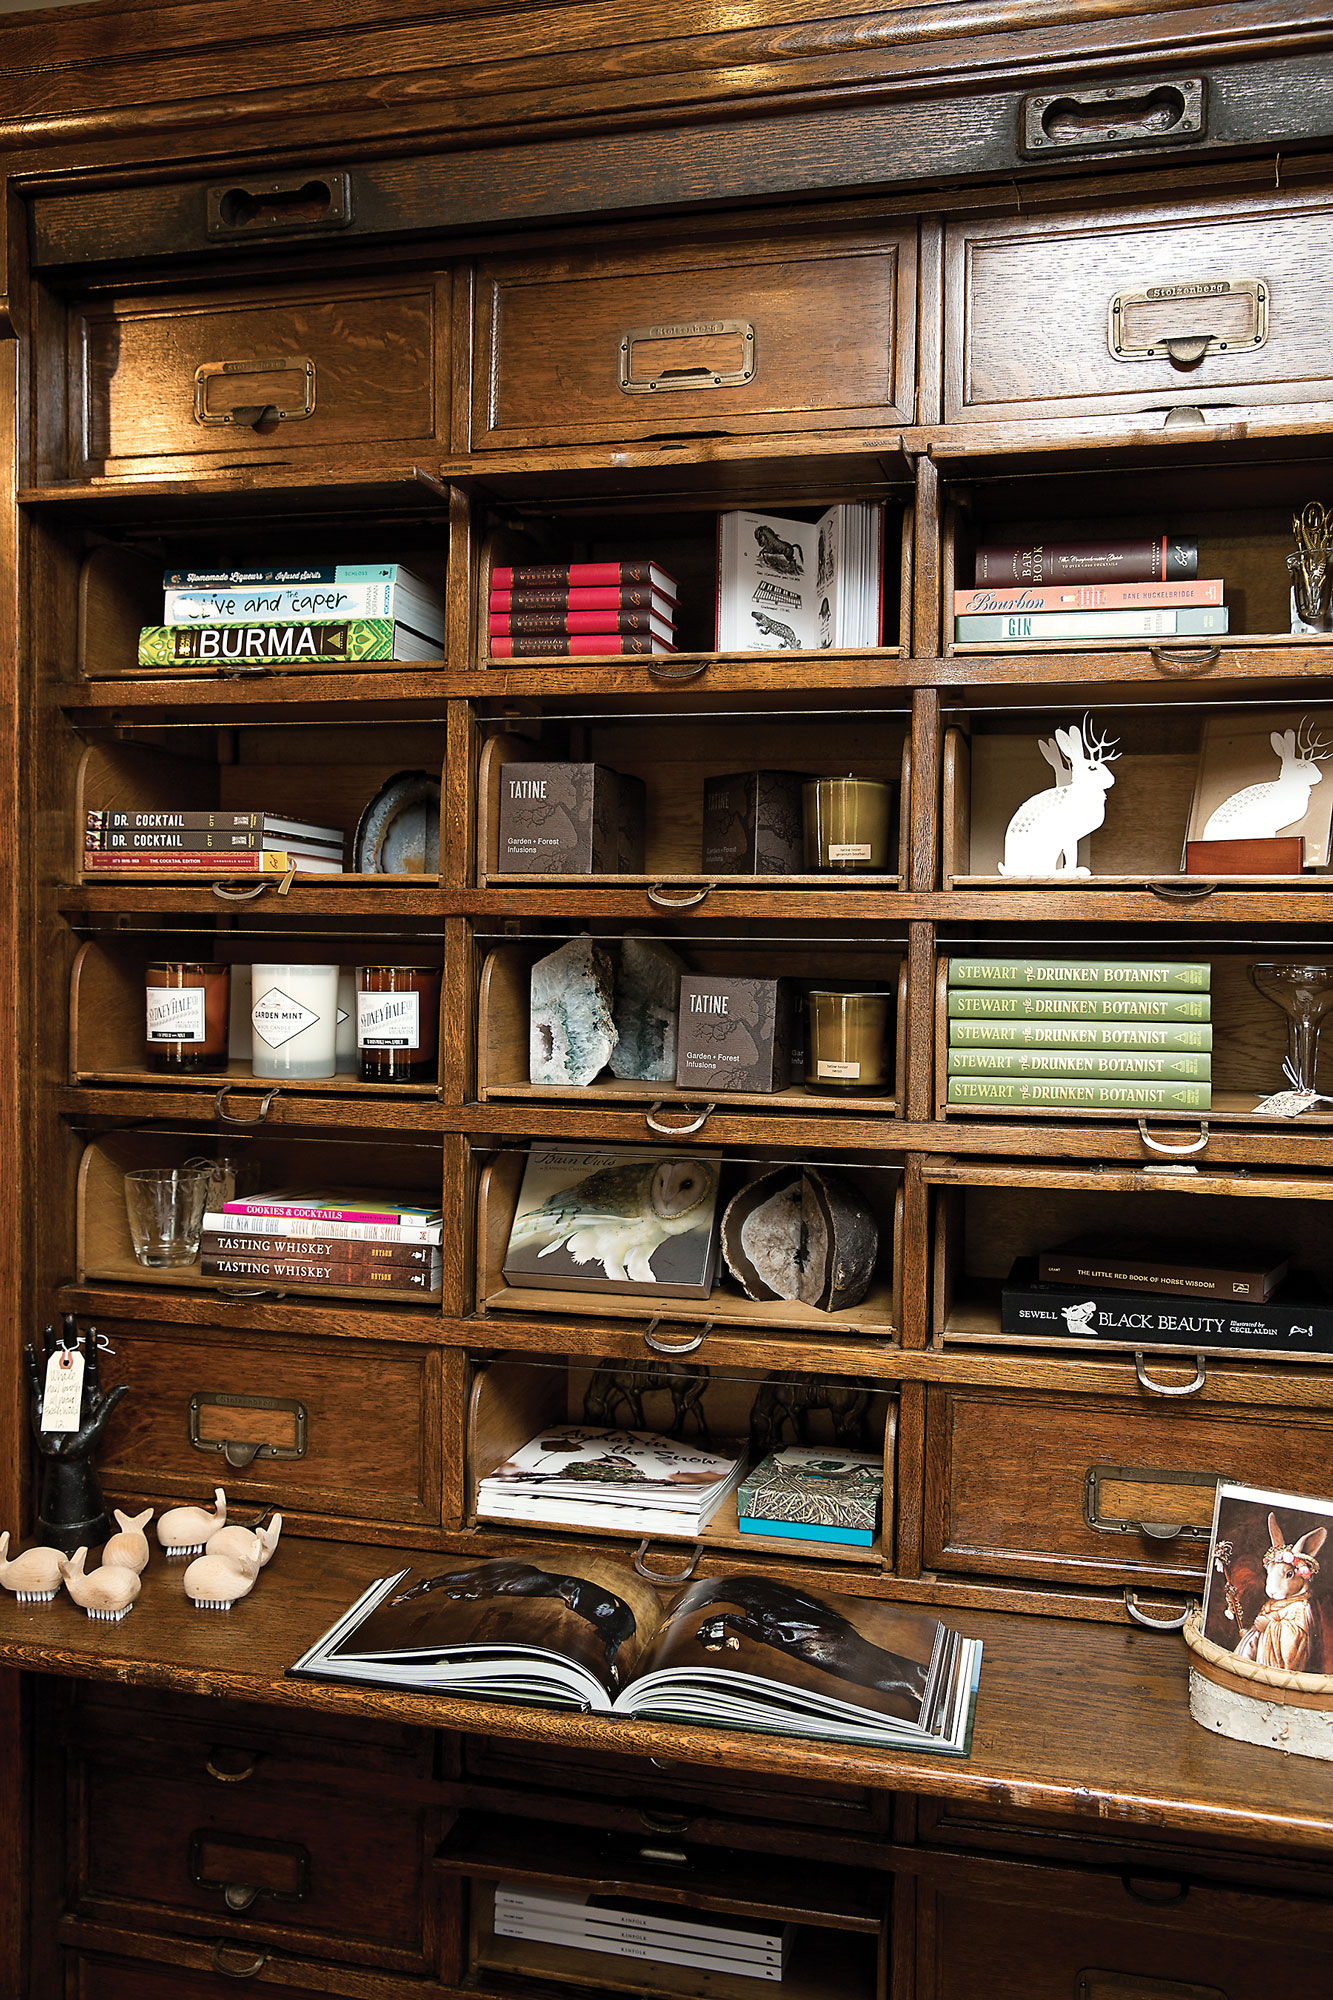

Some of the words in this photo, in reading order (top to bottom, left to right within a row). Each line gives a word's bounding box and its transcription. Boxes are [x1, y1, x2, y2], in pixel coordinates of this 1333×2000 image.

[1153, 283, 1224, 297] Stolzenberg
[1022, 552, 1032, 577] BAR
[1033, 546, 1043, 582] BOOK
[244, 594, 282, 612] and
[286, 590, 298, 598] the
[292, 593, 347, 613] caper
[966, 590, 1045, 612] Bourbon
[1143, 590, 1195, 599] HUCKELBRIDGE
[1008, 618, 1032, 636] GIN
[200, 627, 317, 657] BURMA
[509, 780, 547, 799] TATINE
[114, 814, 129, 826] DR.
[136, 814, 185, 826] COCKTAIL
[112, 834, 128, 846] DR.
[134, 834, 183, 847] COCKTAIL
[508, 837, 532, 845] Garden
[508, 846, 537, 854] Infusions
[958, 966, 1018, 979] STEWART
[1036, 968, 1099, 982] DRUNKEN
[1104, 969, 1170, 983] BOTANIST
[690, 994, 729, 1015] TATINE
[958, 999, 1018, 1012] STEWART
[1035, 1000, 1097, 1014] DRUNKEN
[1102, 1001, 1169, 1015] BOTANIST
[958, 1026, 1017, 1040] STEWART
[1035, 1028, 1097, 1042] DRUNKEN
[1102, 1030, 1168, 1044] BOTANIST
[686, 1052, 712, 1061] Garden
[718, 1053, 740, 1062] Forest
[686, 1060, 717, 1070] Infusions
[954, 1055, 1013, 1068] STEWART
[1031, 1057, 1094, 1071] DRUNKEN
[1098, 1058, 1165, 1072] BOTANIST
[954, 1084, 1014, 1098] STEWART
[1032, 1086, 1094, 1100] DRUNKEN
[1100, 1088, 1166, 1102] BOTANIST
[246, 1206, 285, 1216] COOKIES
[294, 1208, 343, 1220] COCKTAILS
[224, 1216, 234, 1230] THE
[236, 1217, 249, 1231] NEW
[291, 1220, 309, 1235] STEVE
[380, 1226, 402, 1241] SMITH
[218, 1238, 270, 1252] TASTING
[274, 1242, 333, 1255] WHISKEY
[217, 1261, 270, 1274] TASTING
[274, 1264, 332, 1278] WHISKEY
[1129, 1274, 1148, 1282] BOOK
[1161, 1278, 1184, 1286] HORSE
[1185, 1280, 1216, 1288] WISDOM
[1018, 1309, 1058, 1320] SEWELL
[1098, 1312, 1154, 1330] BLACK
[1157, 1315, 1226, 1333] BEAUTY
[1230, 1320, 1257, 1328] Illustrated
[1253, 1328, 1278, 1336] ALDIN
[609, 1444, 645, 1456] the
[654, 1451, 719, 1465] Snow
[622, 1917, 648, 1926] KINFOLK
[621, 1933, 648, 1941] KINFOLK
[621, 1948, 647, 1956] KINFOLK
